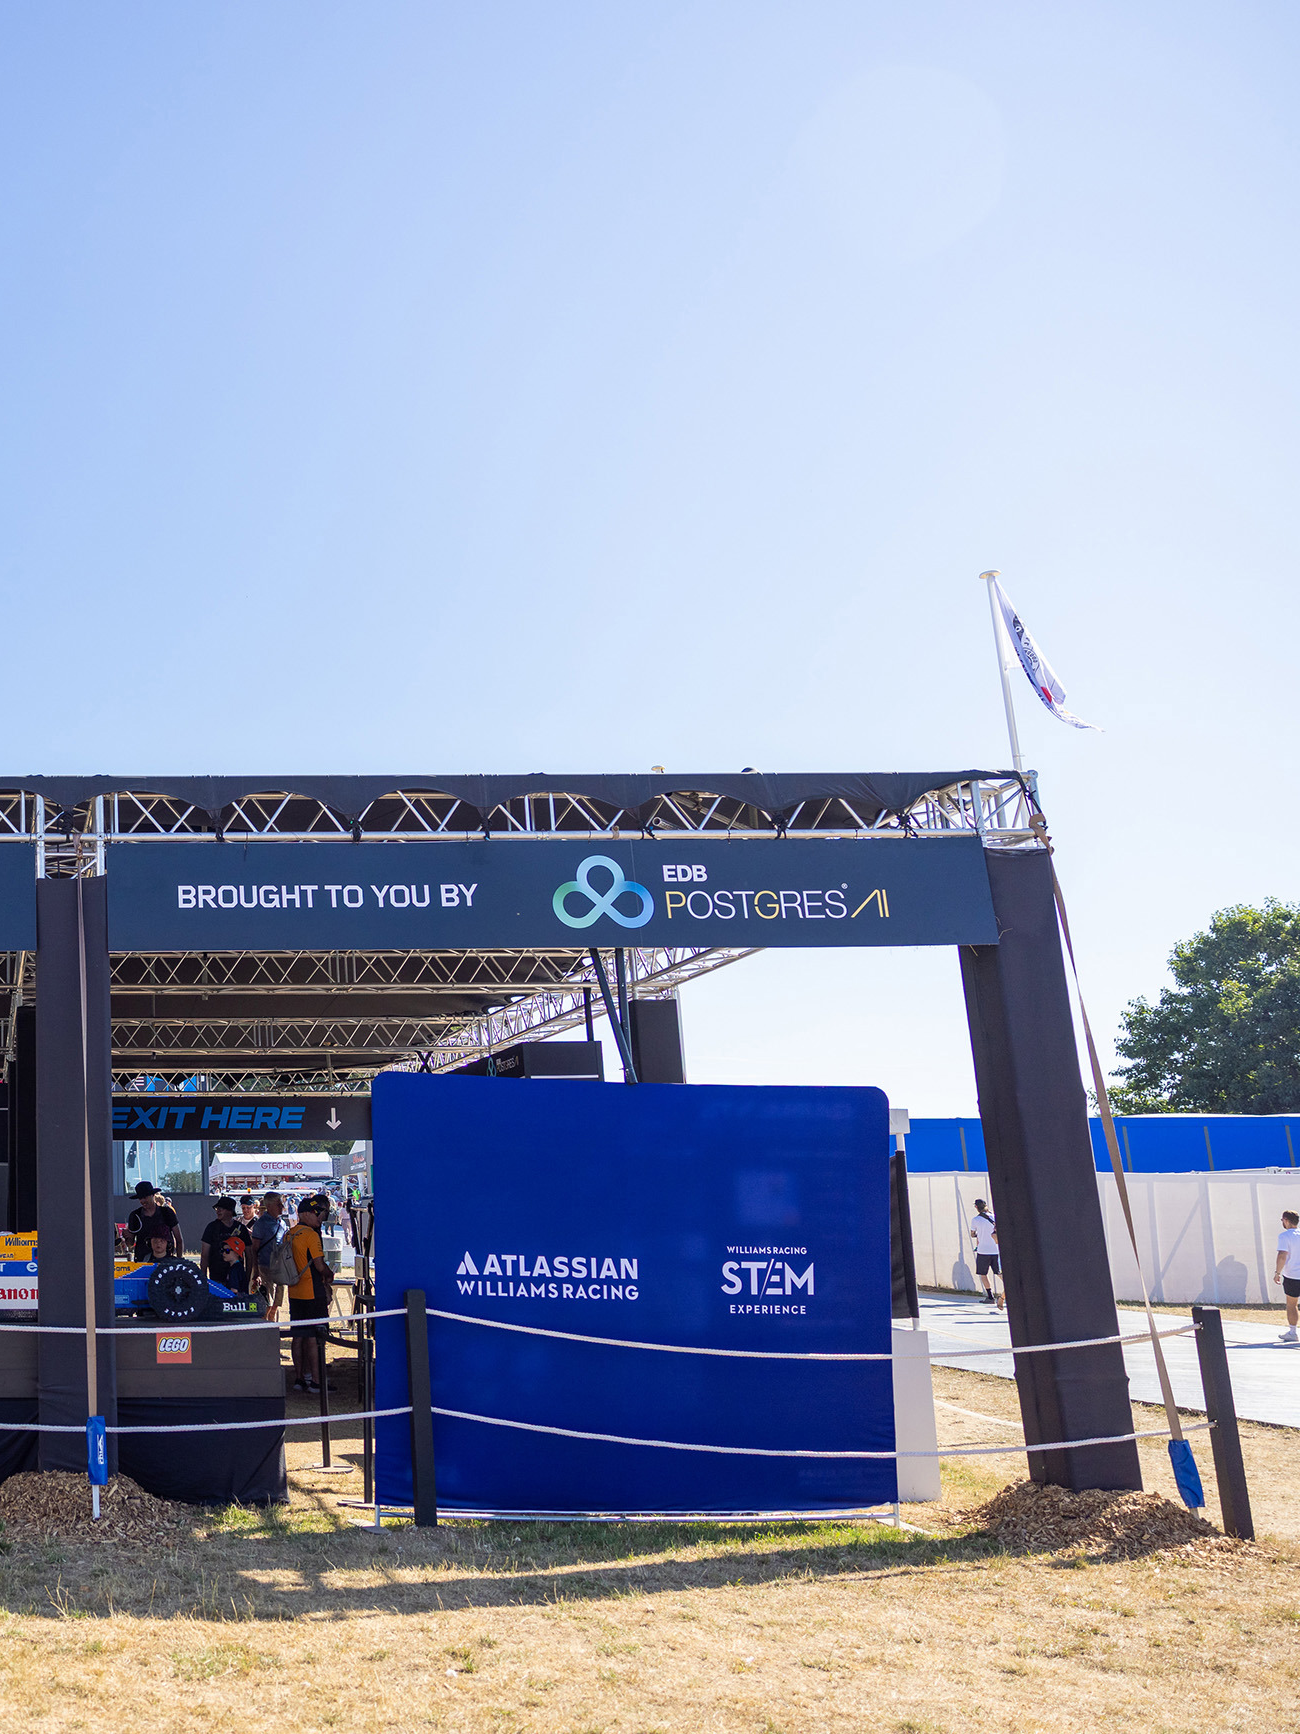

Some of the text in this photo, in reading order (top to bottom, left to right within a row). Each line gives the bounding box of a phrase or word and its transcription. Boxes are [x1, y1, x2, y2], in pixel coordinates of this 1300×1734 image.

[662, 865, 708, 882] EDB
[177, 883, 478, 908] BROUGHT TO YOU BY
[112, 1107, 306, 1129] EXIT HERE
[483, 1254, 638, 1279] ATLASSIAN
[721, 1258, 814, 1298] STEM
[222, 1303, 246, 1311] Bull
[730, 1305, 806, 1314] EXPERIENCE
[158, 1337, 190, 1352] LEGO
